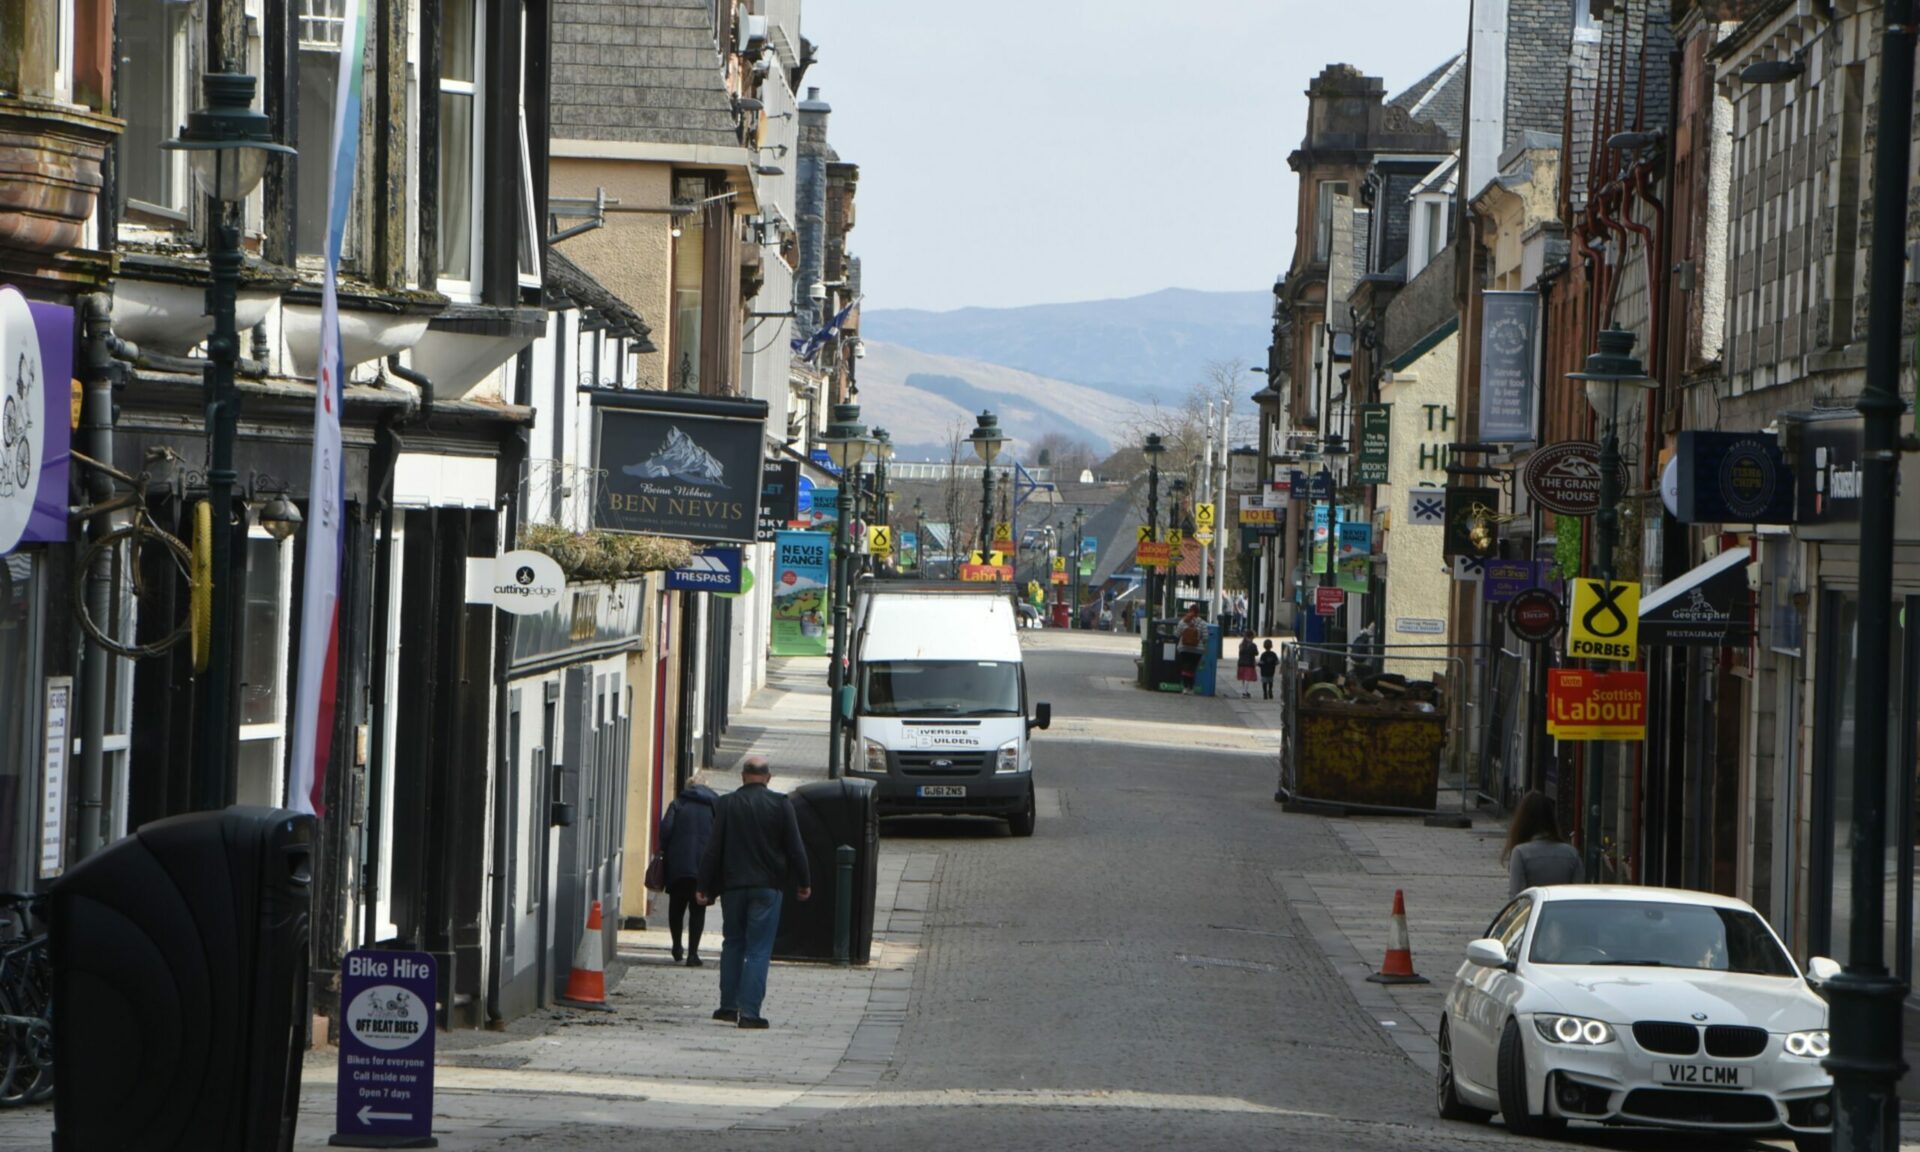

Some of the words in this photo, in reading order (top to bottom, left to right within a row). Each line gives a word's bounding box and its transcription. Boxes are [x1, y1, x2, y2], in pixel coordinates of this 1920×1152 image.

[1361, 463, 1387, 471] BOOKS
[1370, 472, 1386, 480] ART
[640, 482, 672, 496] Beinn
[1540, 478, 1560, 489] THE
[1556, 490, 1596, 501] HOUSE
[610, 493, 659, 513] BEN
[668, 498, 743, 520] NEVIS
[1245, 510, 1258, 520] TO
[781, 545, 823, 556] NEVIS
[781, 555, 823, 566] RANGE
[675, 571, 732, 584] TRESPASS
[1672, 610, 1730, 622] Geographer
[1666, 630, 1726, 639] RESTAURANT
[1573, 640, 1630, 657] FORBES
[1562, 677, 1582, 686] Vote
[1592, 688, 1641, 701] Scottish
[1557, 697, 1641, 721] Labour
[924, 787, 944, 796] GJ61
[946, 787, 963, 797] ZNS
[349, 957, 388, 977] Bike
[393, 958, 430, 979] Hire
[356, 1018, 371, 1032] OFF
[372, 1019, 393, 1033] BEAT
[395, 1020, 419, 1034] BIKES
[347, 1055, 370, 1065] Bikes
[372, 1055, 384, 1065] for
[386, 1057, 424, 1067] everyone
[353, 1071, 370, 1080] Call
[400, 1073, 417, 1083] now
[1669, 1064, 1697, 1081] V12
[1702, 1066, 1738, 1084] CMM
[359, 1087, 381, 1098] Open
[383, 1088, 389, 1097] 7
[391, 1088, 411, 1099] days
